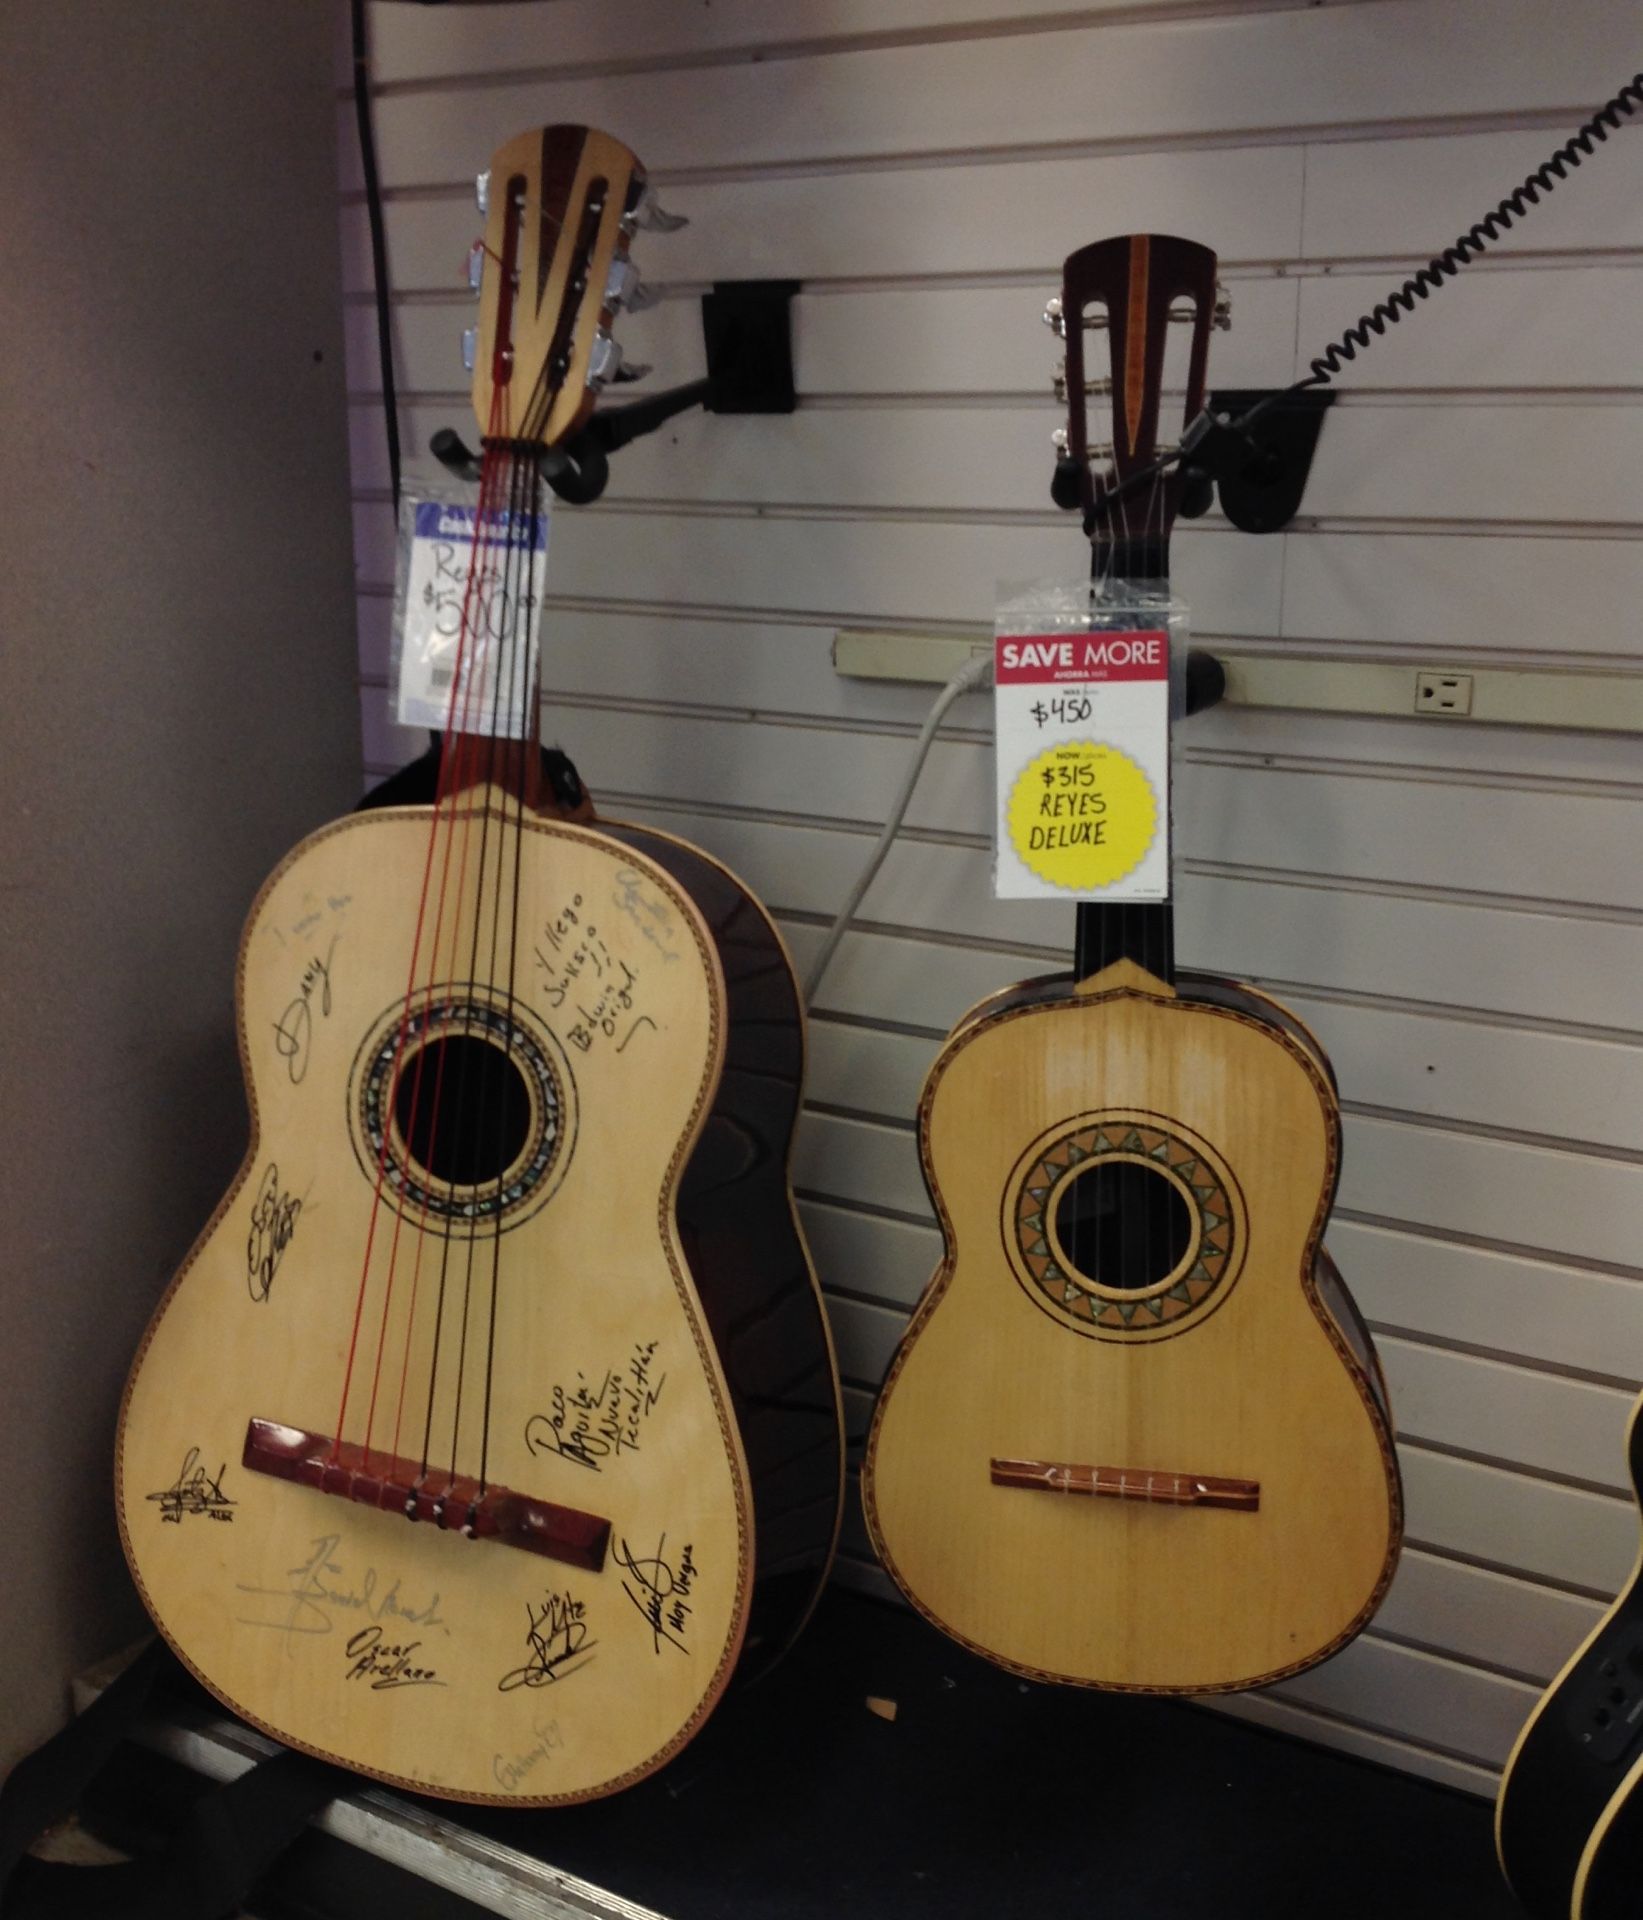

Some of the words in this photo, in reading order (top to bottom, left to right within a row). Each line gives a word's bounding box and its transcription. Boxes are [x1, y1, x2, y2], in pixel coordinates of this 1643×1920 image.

[1002, 642, 1074, 669] SAVE
[1083, 639, 1161, 666] MORE
[1030, 697, 1093, 729] $450
[1041, 763, 1096, 788] $315
[1039, 792, 1107, 817] REYES
[1028, 820, 1107, 850] DELUXE
